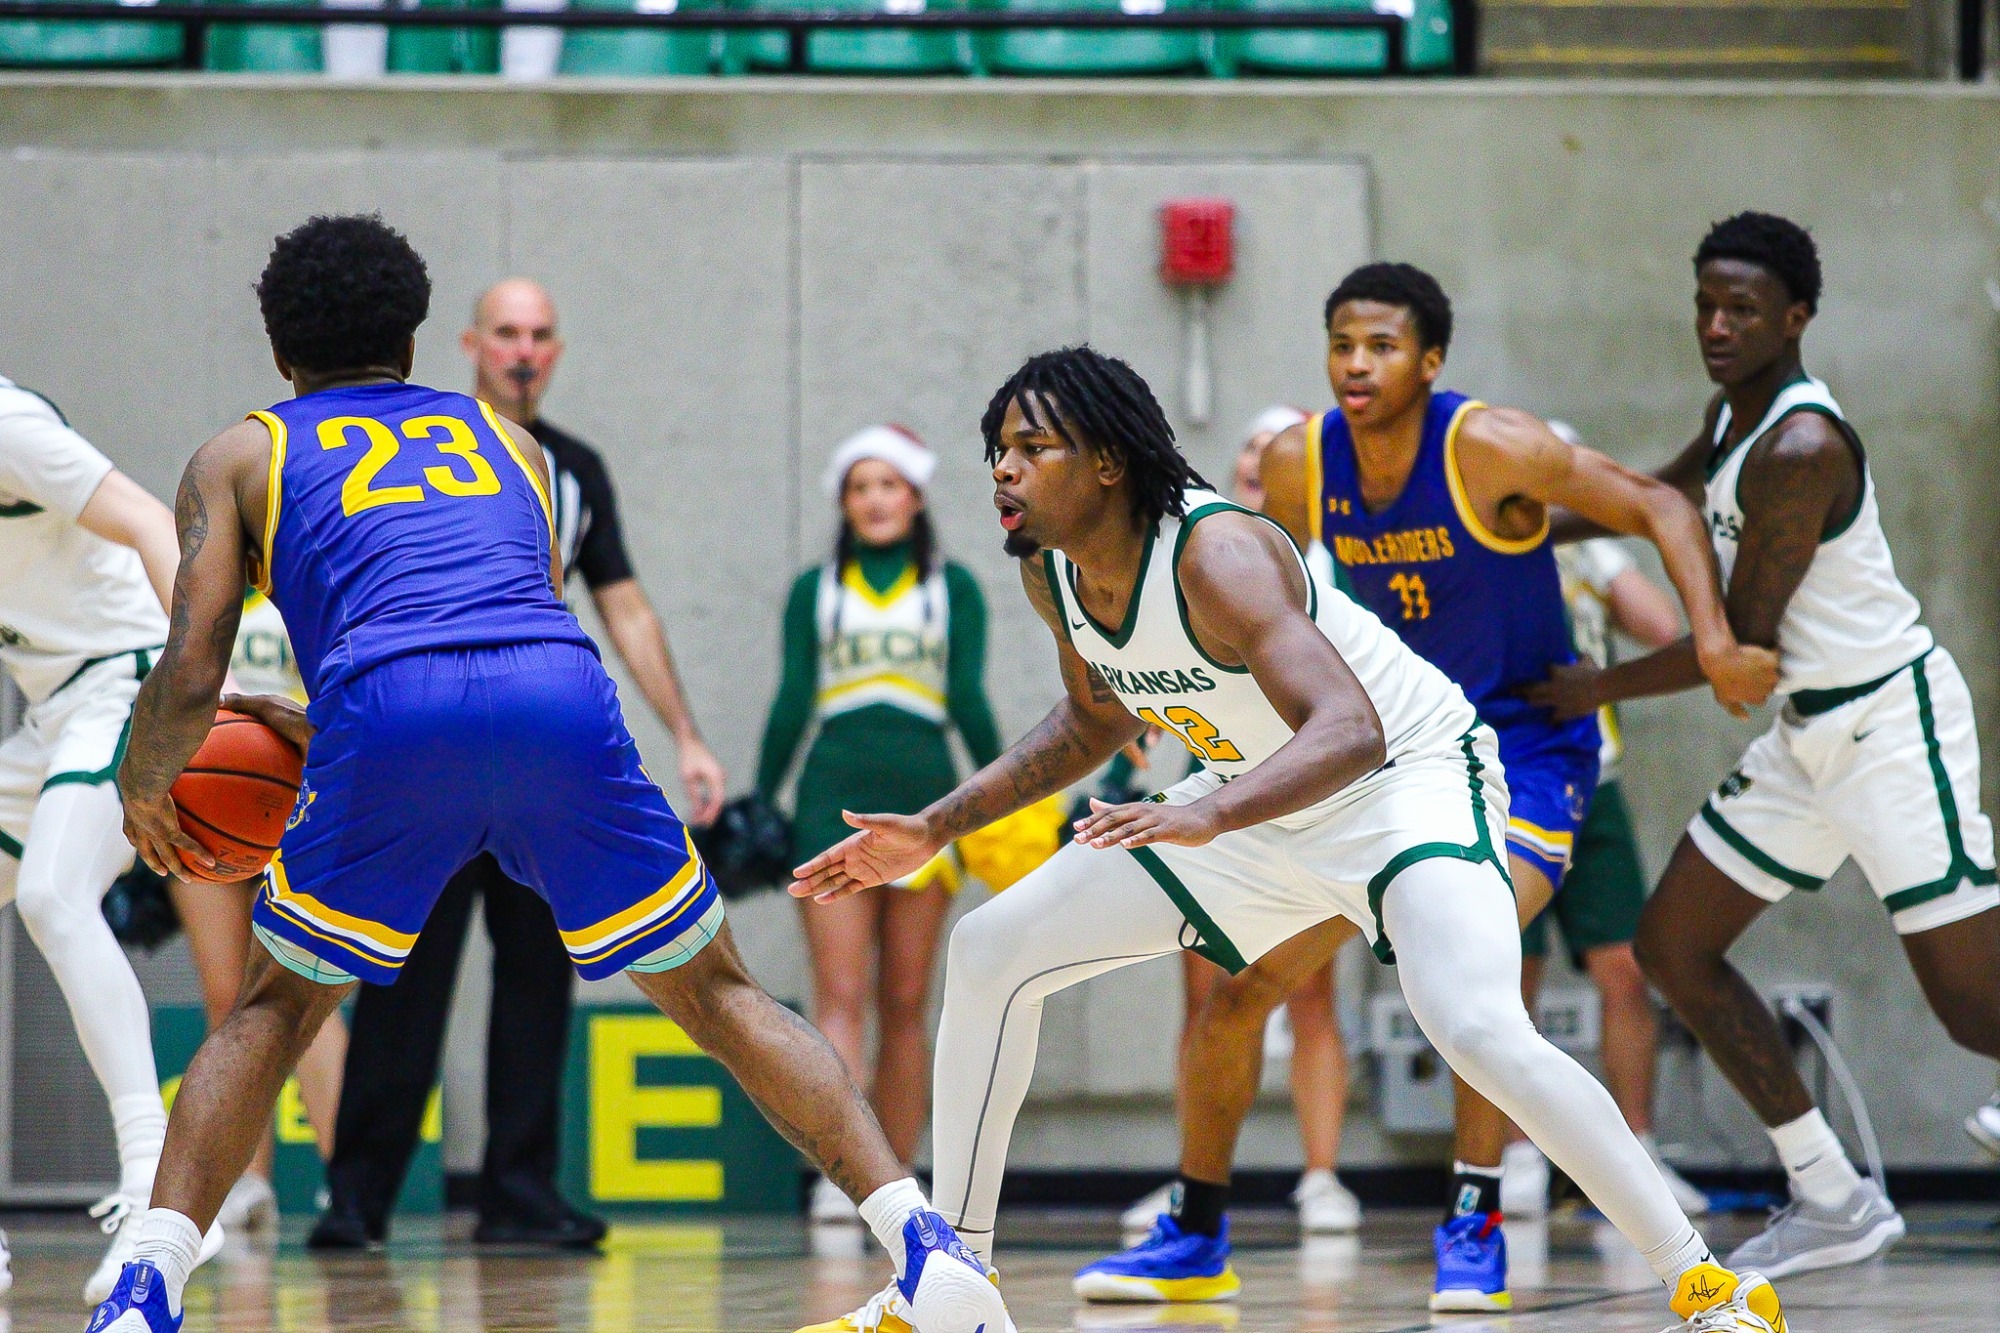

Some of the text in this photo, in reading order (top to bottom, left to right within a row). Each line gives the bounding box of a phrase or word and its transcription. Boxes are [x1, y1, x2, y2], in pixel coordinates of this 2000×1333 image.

[316, 415, 502, 518] 23
[1137, 706, 1246, 761] 12
[589, 1016, 724, 1200] E
